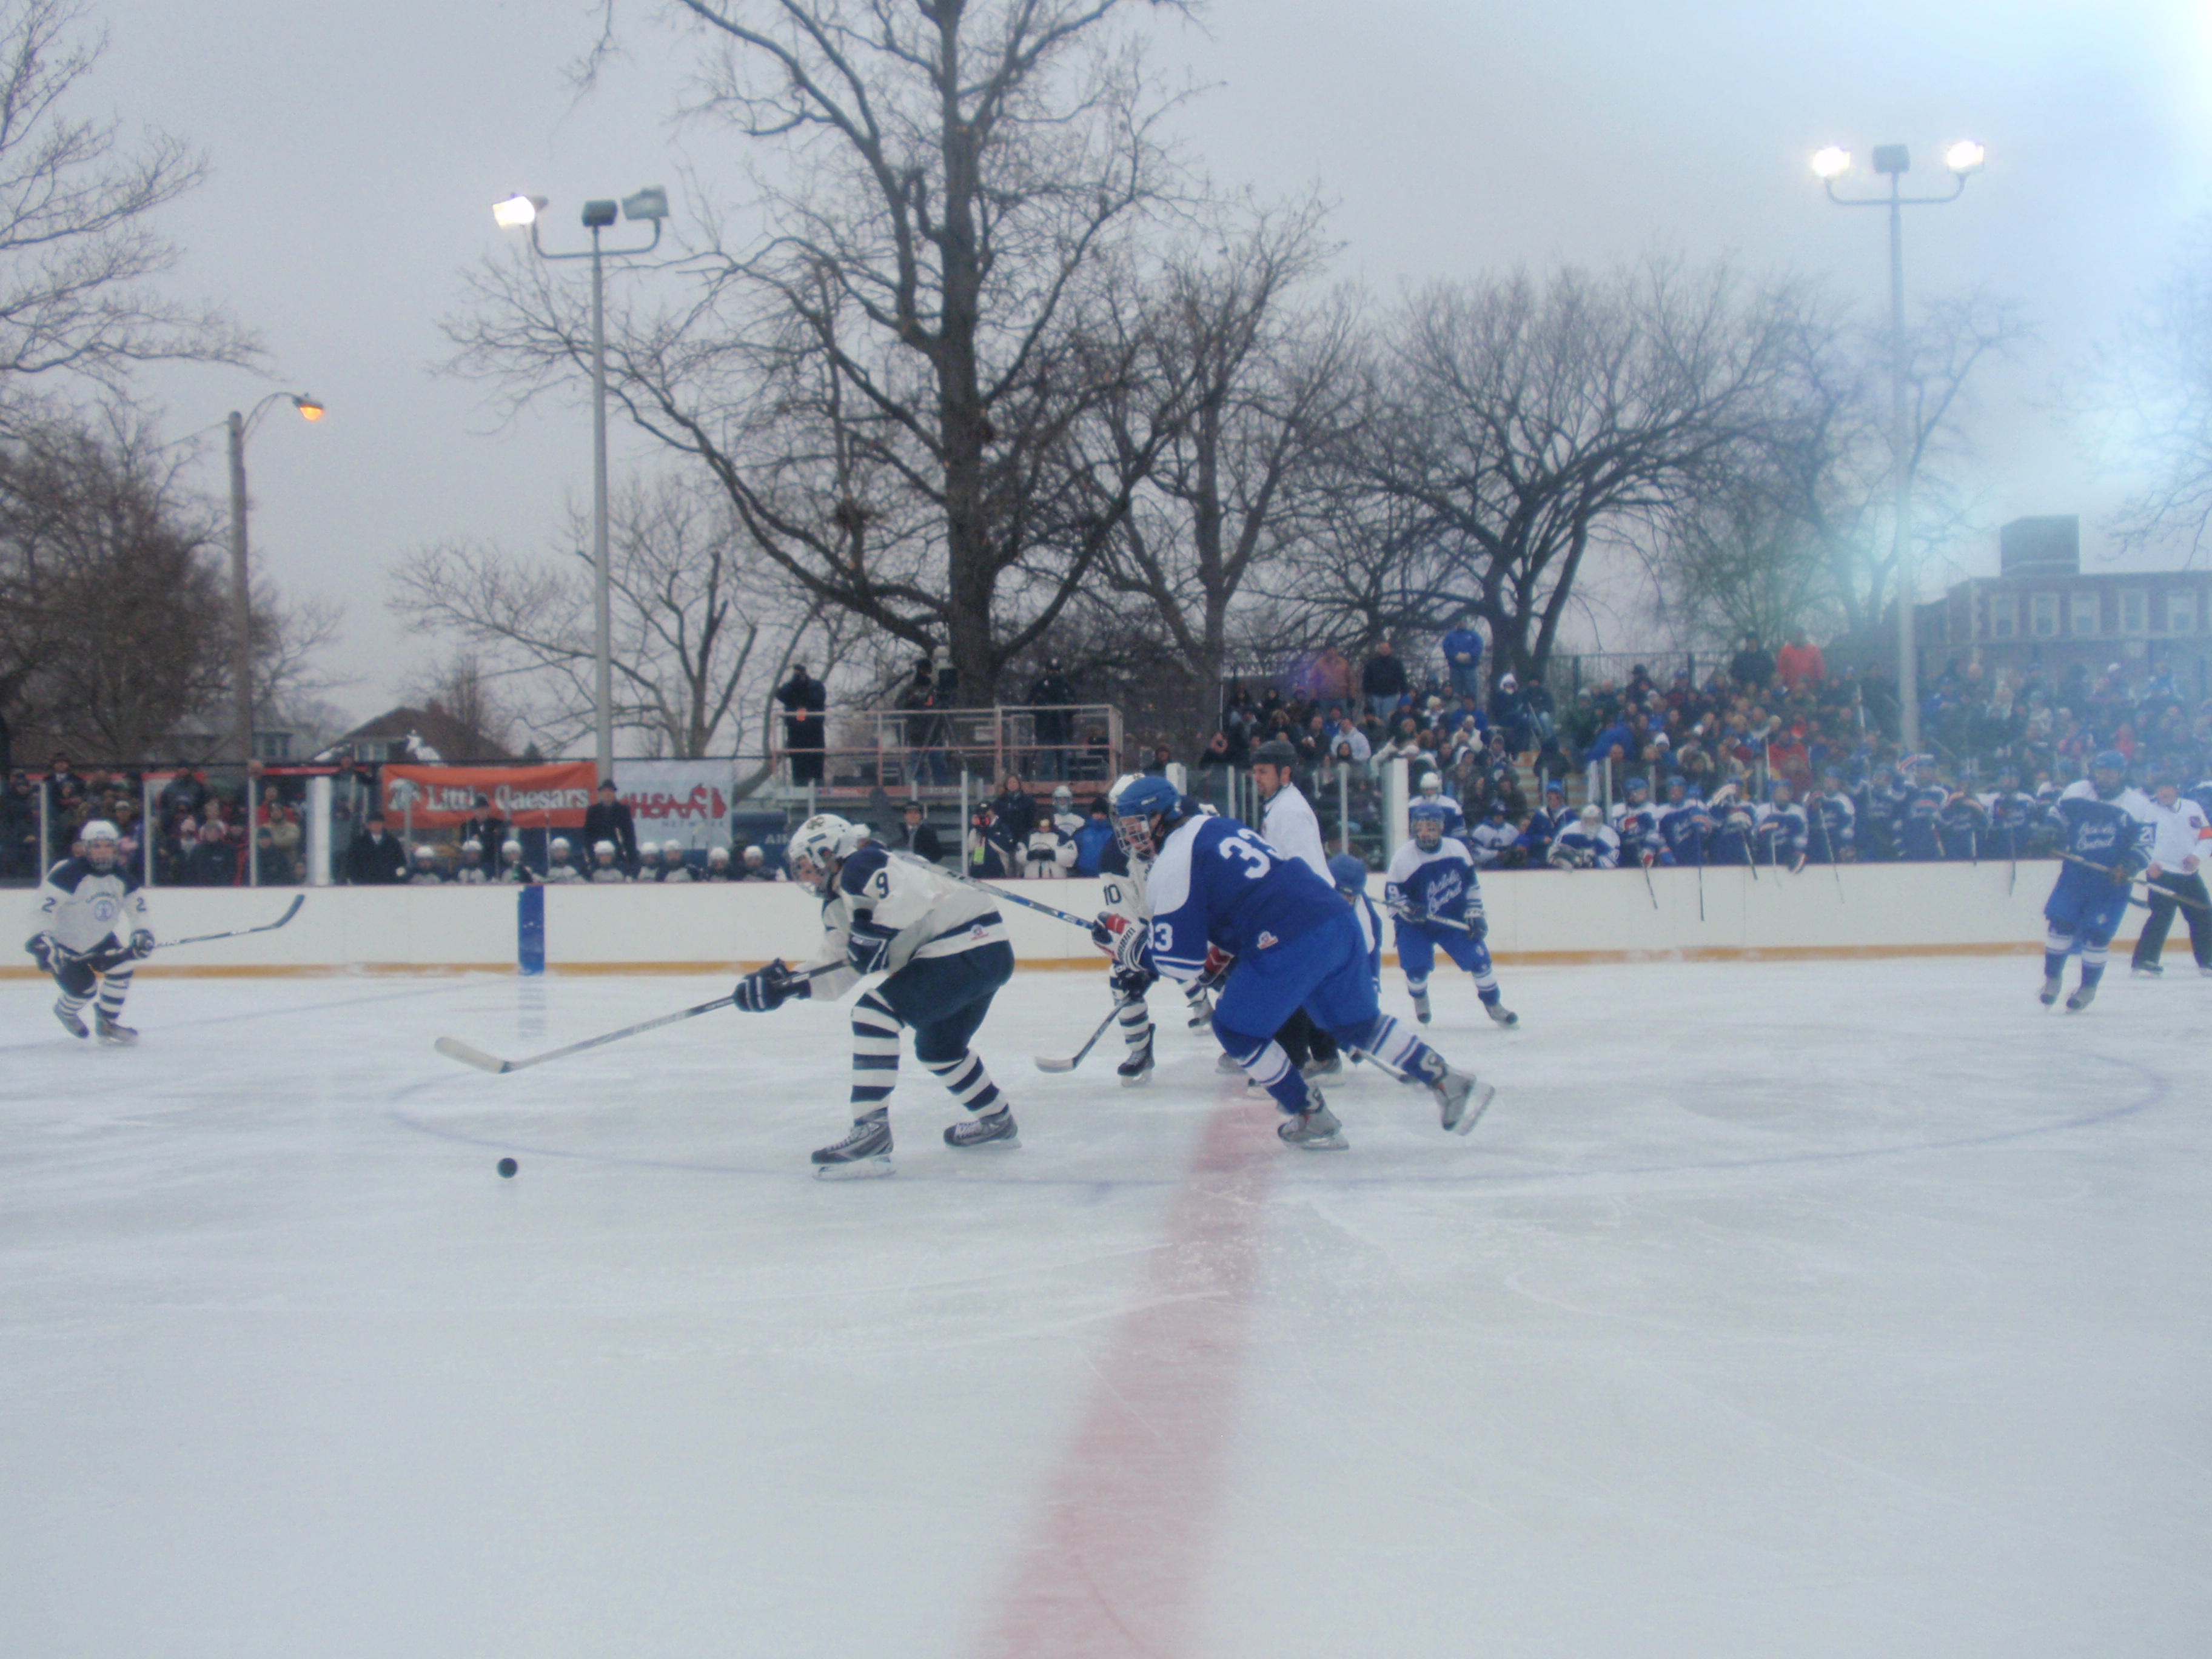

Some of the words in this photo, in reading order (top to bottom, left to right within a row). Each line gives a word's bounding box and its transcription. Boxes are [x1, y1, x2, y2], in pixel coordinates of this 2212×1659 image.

[495, 784, 589, 810] Caesars
[876, 871, 890, 899] 9
[1103, 884, 1122, 905] 10
[42, 897, 56, 913] 2
[136, 897, 147, 911] 2
